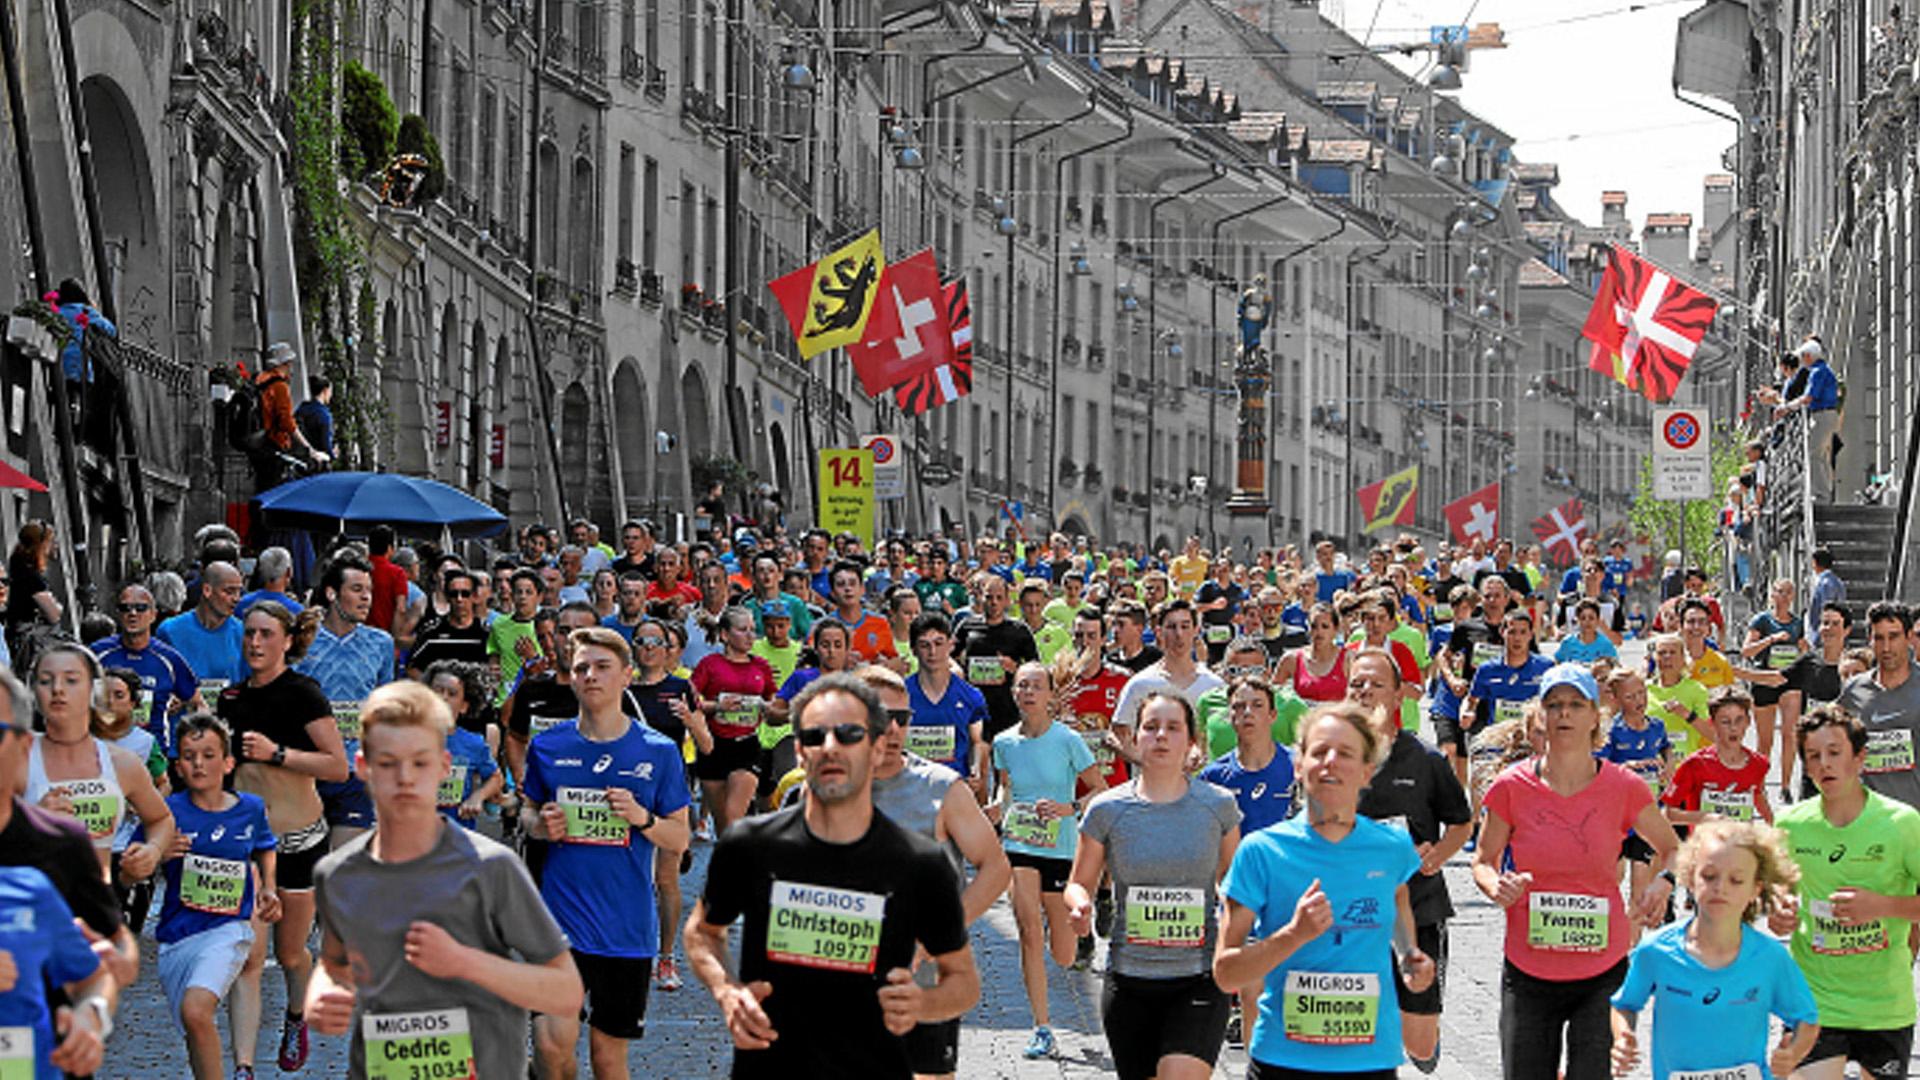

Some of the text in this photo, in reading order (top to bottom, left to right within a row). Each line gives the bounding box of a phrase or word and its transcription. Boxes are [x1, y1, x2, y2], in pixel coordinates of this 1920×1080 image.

[827, 456, 863, 488] 14
[577, 806, 609, 823] Lars
[194, 858, 241, 876] MIGROS
[788, 887, 867, 912] MIGROS
[1136, 890, 1194, 902] MIGROS
[1540, 895, 1598, 910] MIGROS
[1144, 905, 1187, 921] Linda
[1540, 911, 1596, 929] Yvonne
[776, 908, 875, 940] Christoph
[813, 939, 869, 960] 10977
[1296, 976, 1366, 992] MIGROS
[1295, 994, 1366, 1015] Simone
[376, 1014, 451, 1033] MIGROS
[384, 1036, 452, 1060] Cedric
[409, 1059, 469, 1080] 31034
